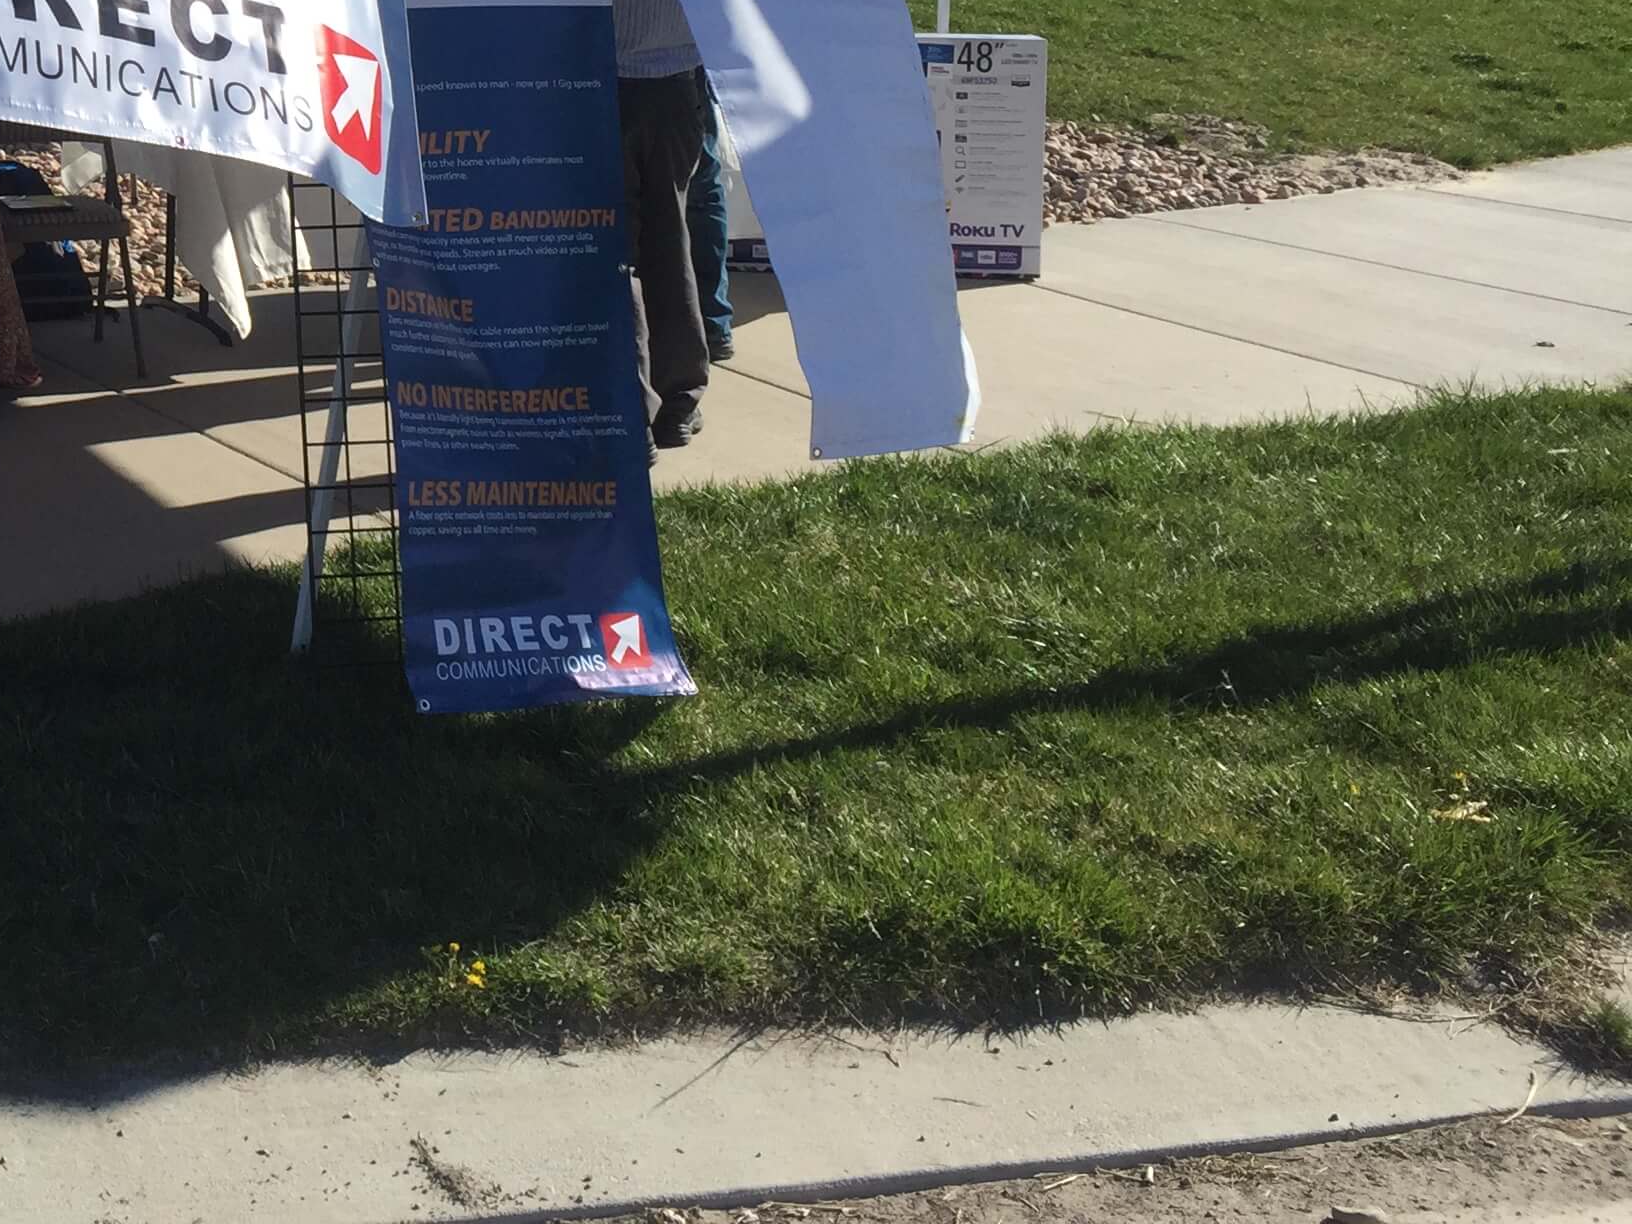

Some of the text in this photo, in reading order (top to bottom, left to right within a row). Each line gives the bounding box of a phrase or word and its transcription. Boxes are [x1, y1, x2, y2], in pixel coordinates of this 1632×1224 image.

[416, 80, 444, 93] speed
[445, 79, 477, 90] known
[478, 79, 488, 88] to
[489, 79, 510, 88] man
[439, 157, 455, 168] the
[457, 156, 484, 168] home
[485, 155, 520, 168] virtually
[489, 208, 617, 231] BANDWIDTH
[999, 223, 1025, 238] TV
[386, 287, 473, 322] DISTANCE
[397, 381, 591, 413] NO INTERFERENCE
[408, 480, 617, 506] LESS MAINTENANCE
[434, 614, 592, 656] DIRECT
[436, 653, 607, 681] COMMUNICATIONS
